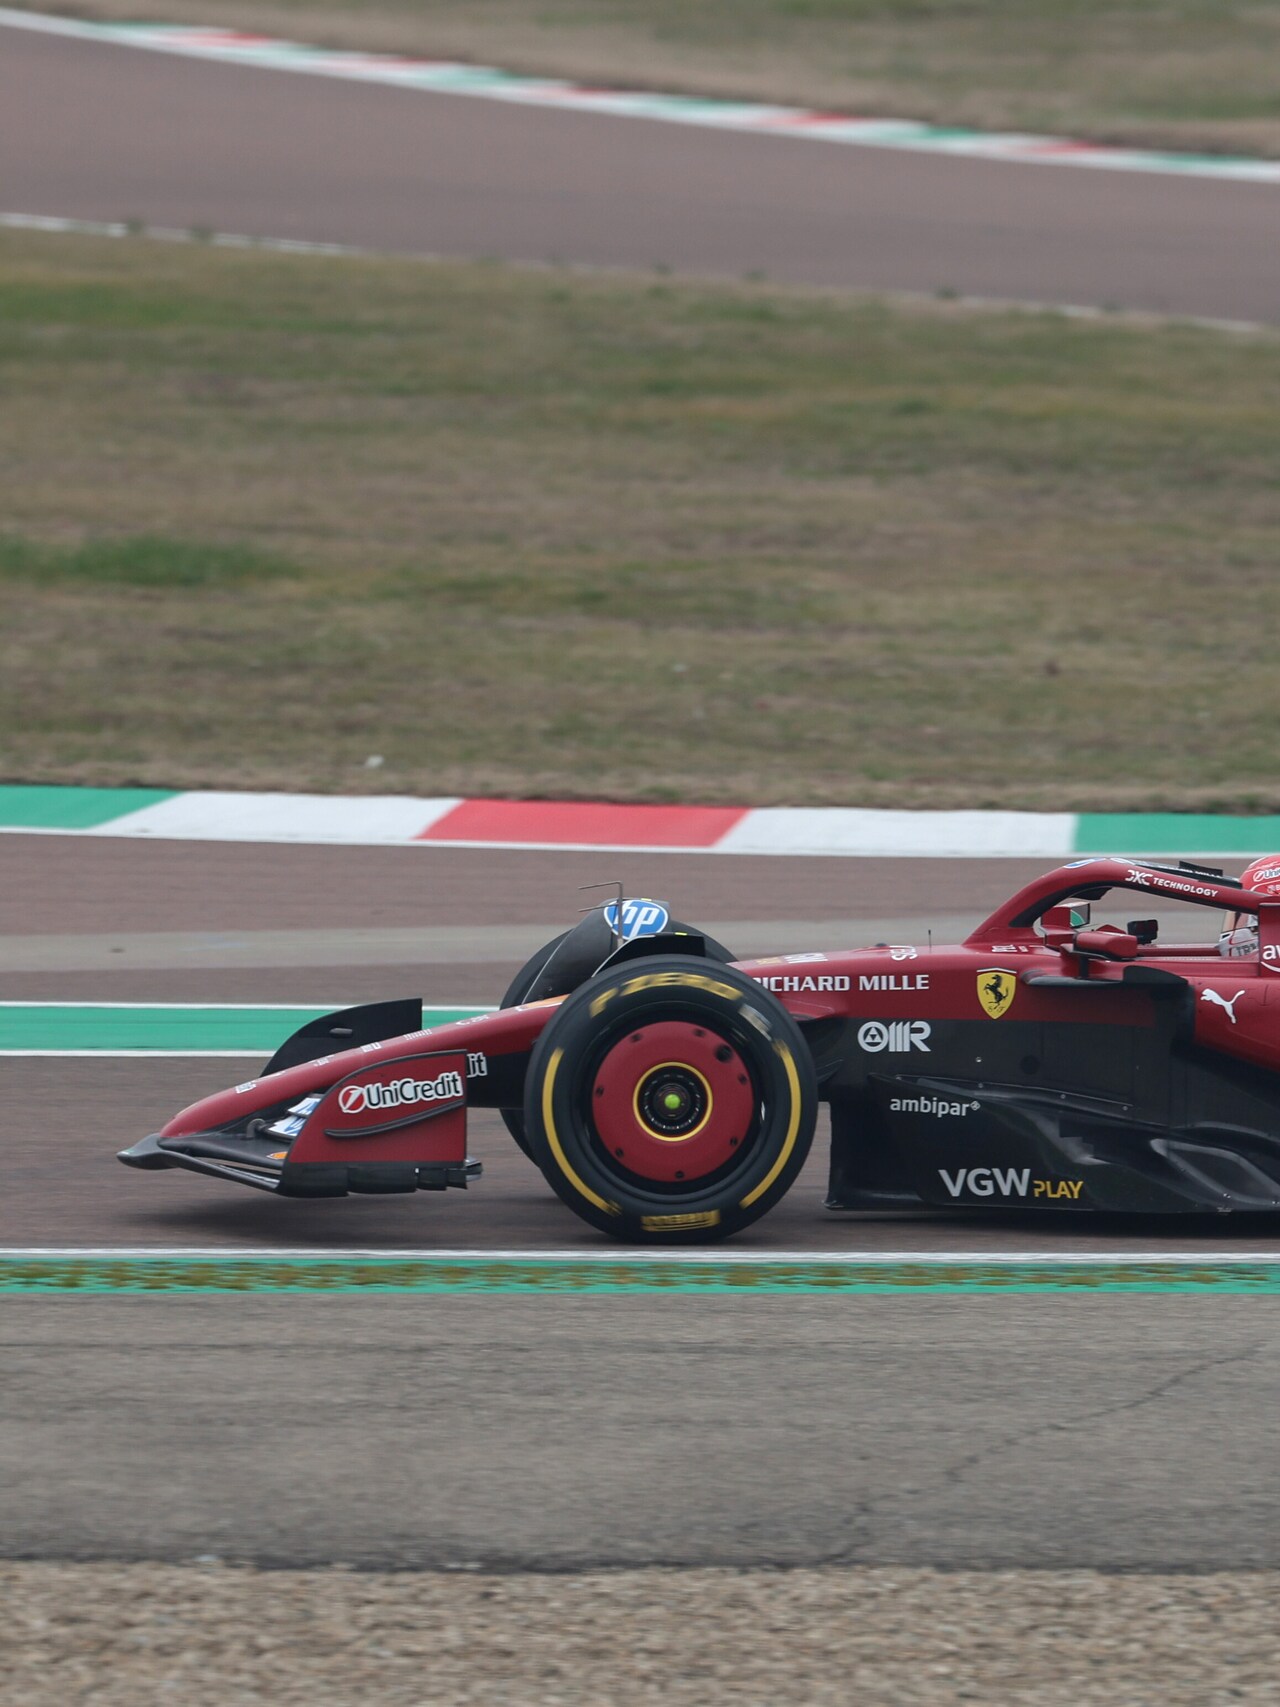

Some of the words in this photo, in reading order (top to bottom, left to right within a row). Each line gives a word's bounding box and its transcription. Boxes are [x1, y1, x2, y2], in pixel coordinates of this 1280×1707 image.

[1153, 877, 1219, 898] TECHNOLOGY
[752, 976, 850, 992] ICHARD
[859, 974, 930, 991] MILLE
[365, 1072, 463, 1109] UniCredit
[890, 1096, 970, 1118] ambipar
[938, 1167, 1031, 1198] VGW
[1033, 1180, 1084, 1199] PLAY
